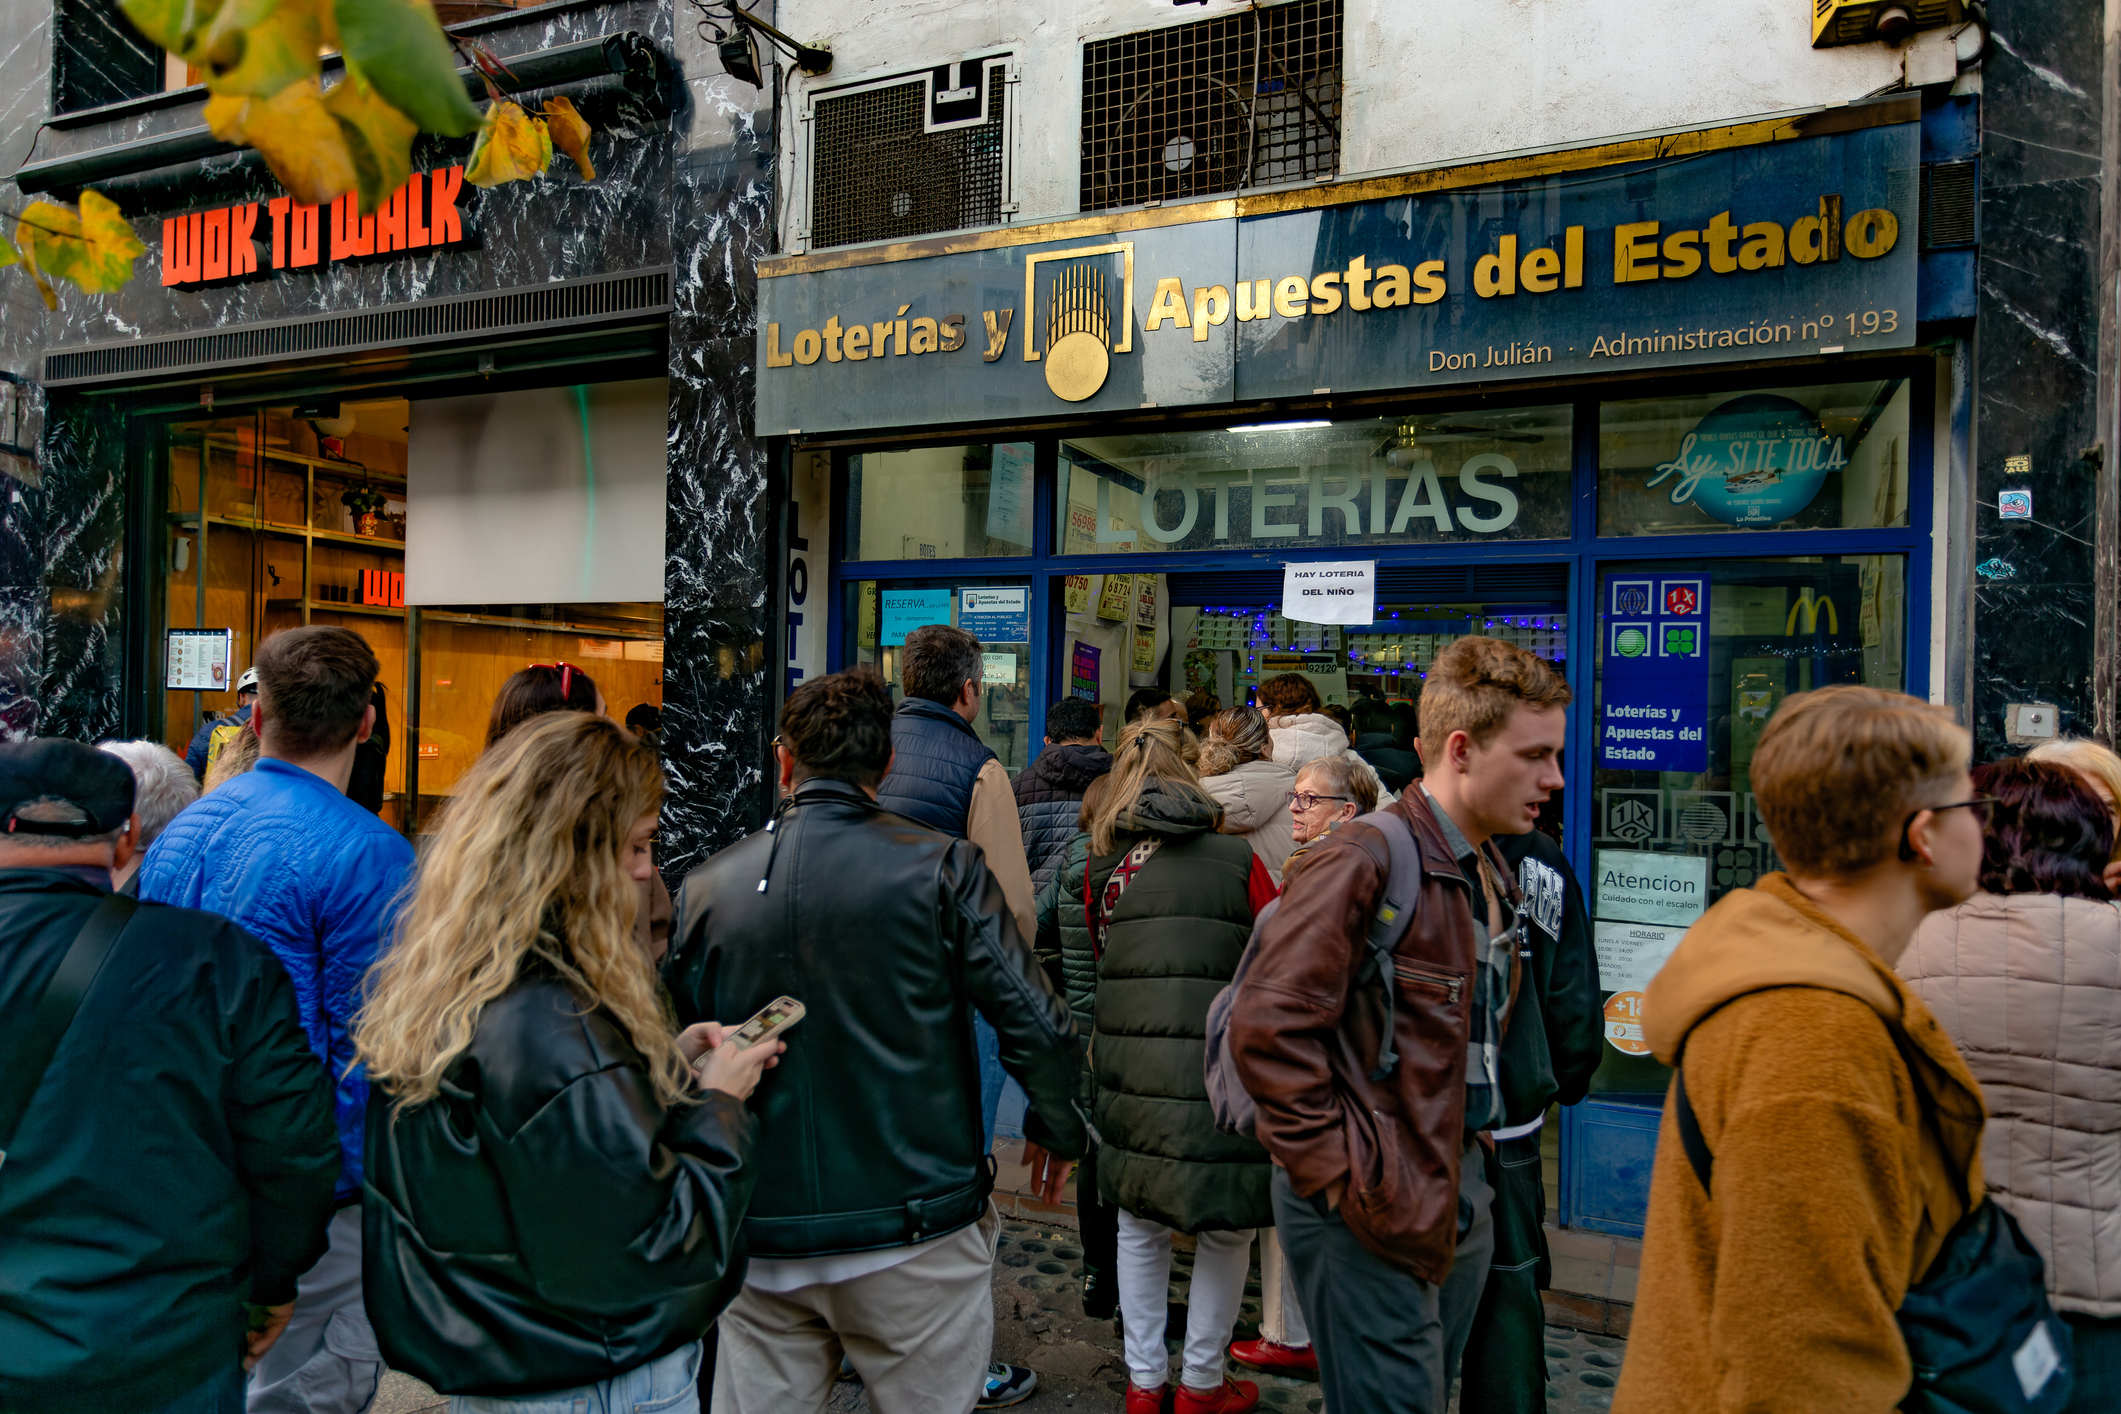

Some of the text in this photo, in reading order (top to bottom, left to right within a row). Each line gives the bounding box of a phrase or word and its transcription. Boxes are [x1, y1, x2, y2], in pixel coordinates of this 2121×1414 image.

[162, 165, 464, 286] WOK TO WALK
[767, 194, 1899, 368] Loterías y Apuestas del Estado
[1429, 309, 1898, 373] Don Julián Administración nº 193
[1725, 440, 1750, 473] SI
[1755, 439, 1782, 472] TE
[1786, 436, 1848, 473] TOCA
[1096, 453, 1519, 544] LOTERIAS
[919, 543, 936, 558] BOTES
[1302, 587, 1355, 596] DEL NIÑO
[1308, 664, 1337, 673] 92120
[1073, 676, 1097, 692] DURANTE
[1606, 704, 1681, 722] Loterías y
[1605, 725, 1702, 742] Apuestas del
[1605, 746, 1656, 761] Estado
[1603, 870, 1695, 894] Atencion
[1602, 893, 1699, 910] Cuidado con el escalon
[1629, 929, 1665, 940] HORARIO
